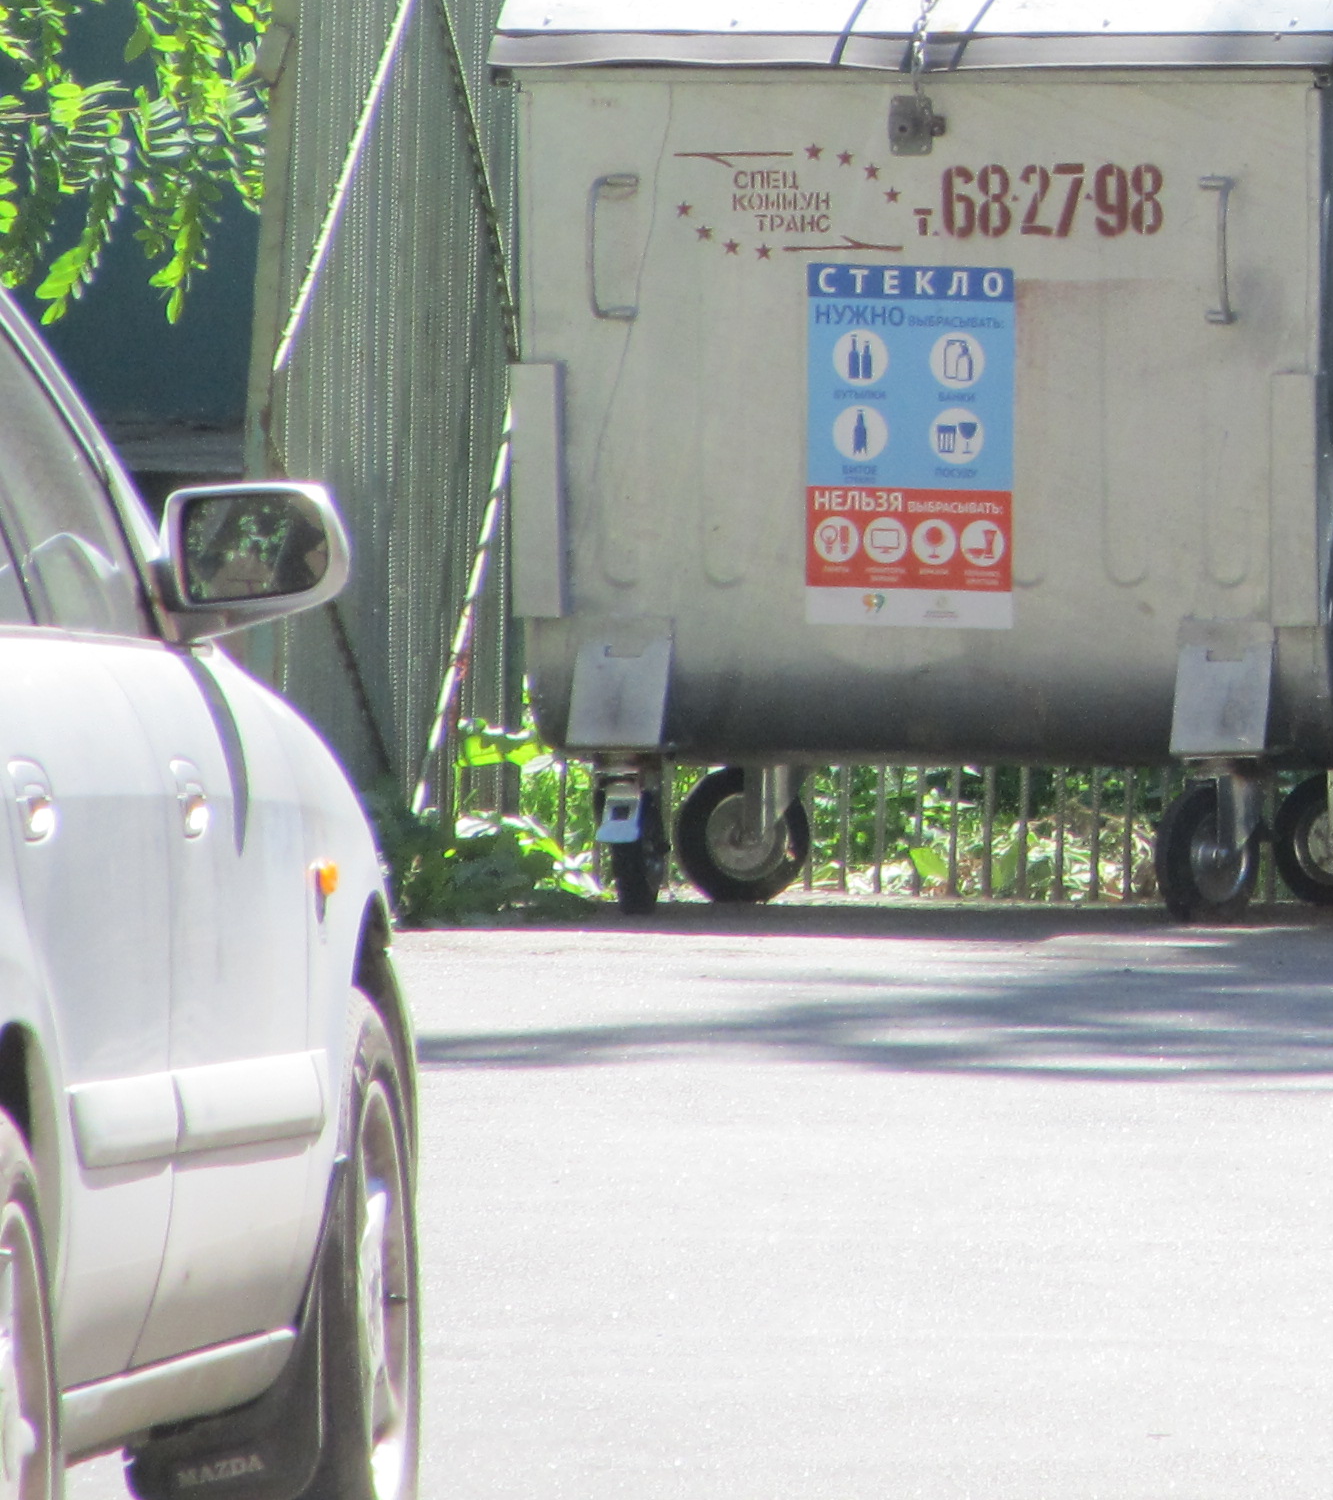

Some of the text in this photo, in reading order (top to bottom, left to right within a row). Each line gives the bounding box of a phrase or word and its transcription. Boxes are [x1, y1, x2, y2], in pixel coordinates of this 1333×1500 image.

[733, 170, 799, 190] СПЕЦ
[732, 192, 831, 212] КОММУН
[754, 214, 831, 233] ТРАНС
[818, 267, 1004, 298] СТЕКЛО
[814, 304, 1005, 329] НУЖНО ВЫБРАСЫВАТЬ:
[813, 490, 1004, 515] НЕЛЬЗЯ ВЫБРАСЫВАТЬ:
